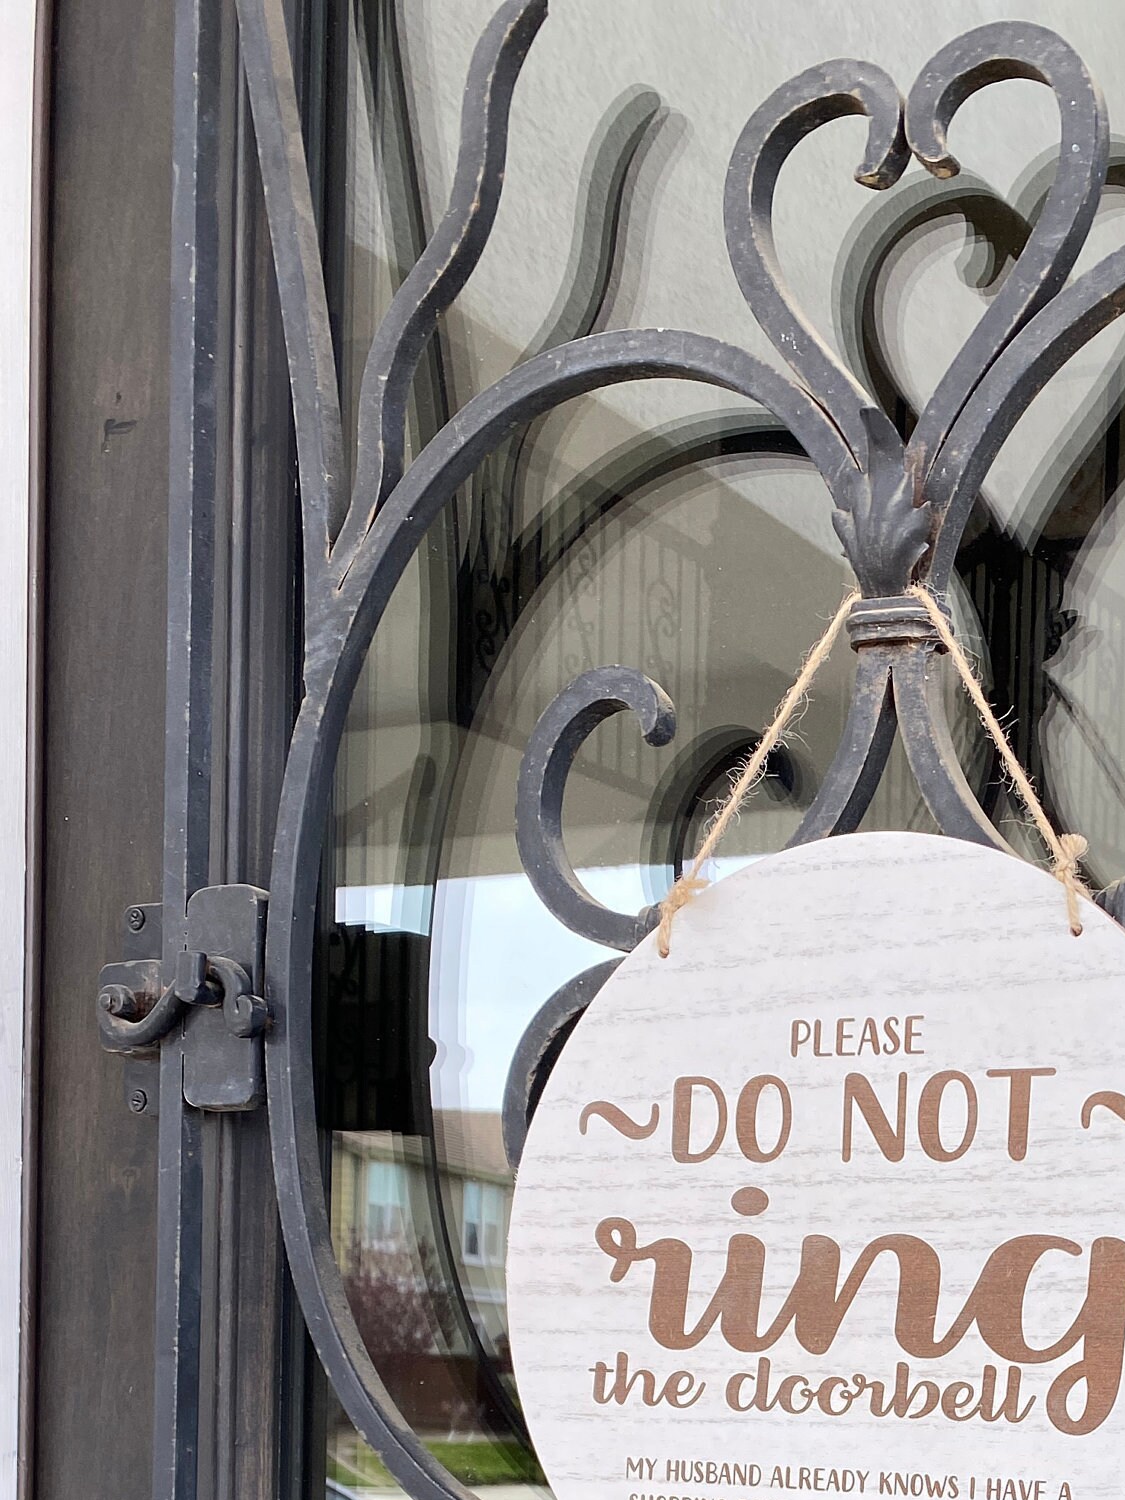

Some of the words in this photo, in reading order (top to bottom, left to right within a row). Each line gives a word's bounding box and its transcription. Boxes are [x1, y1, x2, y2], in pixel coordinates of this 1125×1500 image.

[790, 1015, 925, 1058] PLEASE
[671, 1074, 792, 1165] DO
[842, 1067, 1057, 1164] NOT
[588, 1351, 707, 1408] the
[725, 1356, 1037, 1424] doorbell
[625, 1457, 658, 1481] MY
[666, 1459, 762, 1487] HUSBAND
[770, 1465, 870, 1494] ALREADY
[878, 1472, 959, 1500] KNOWS
[969, 1476, 976, 1500] I
